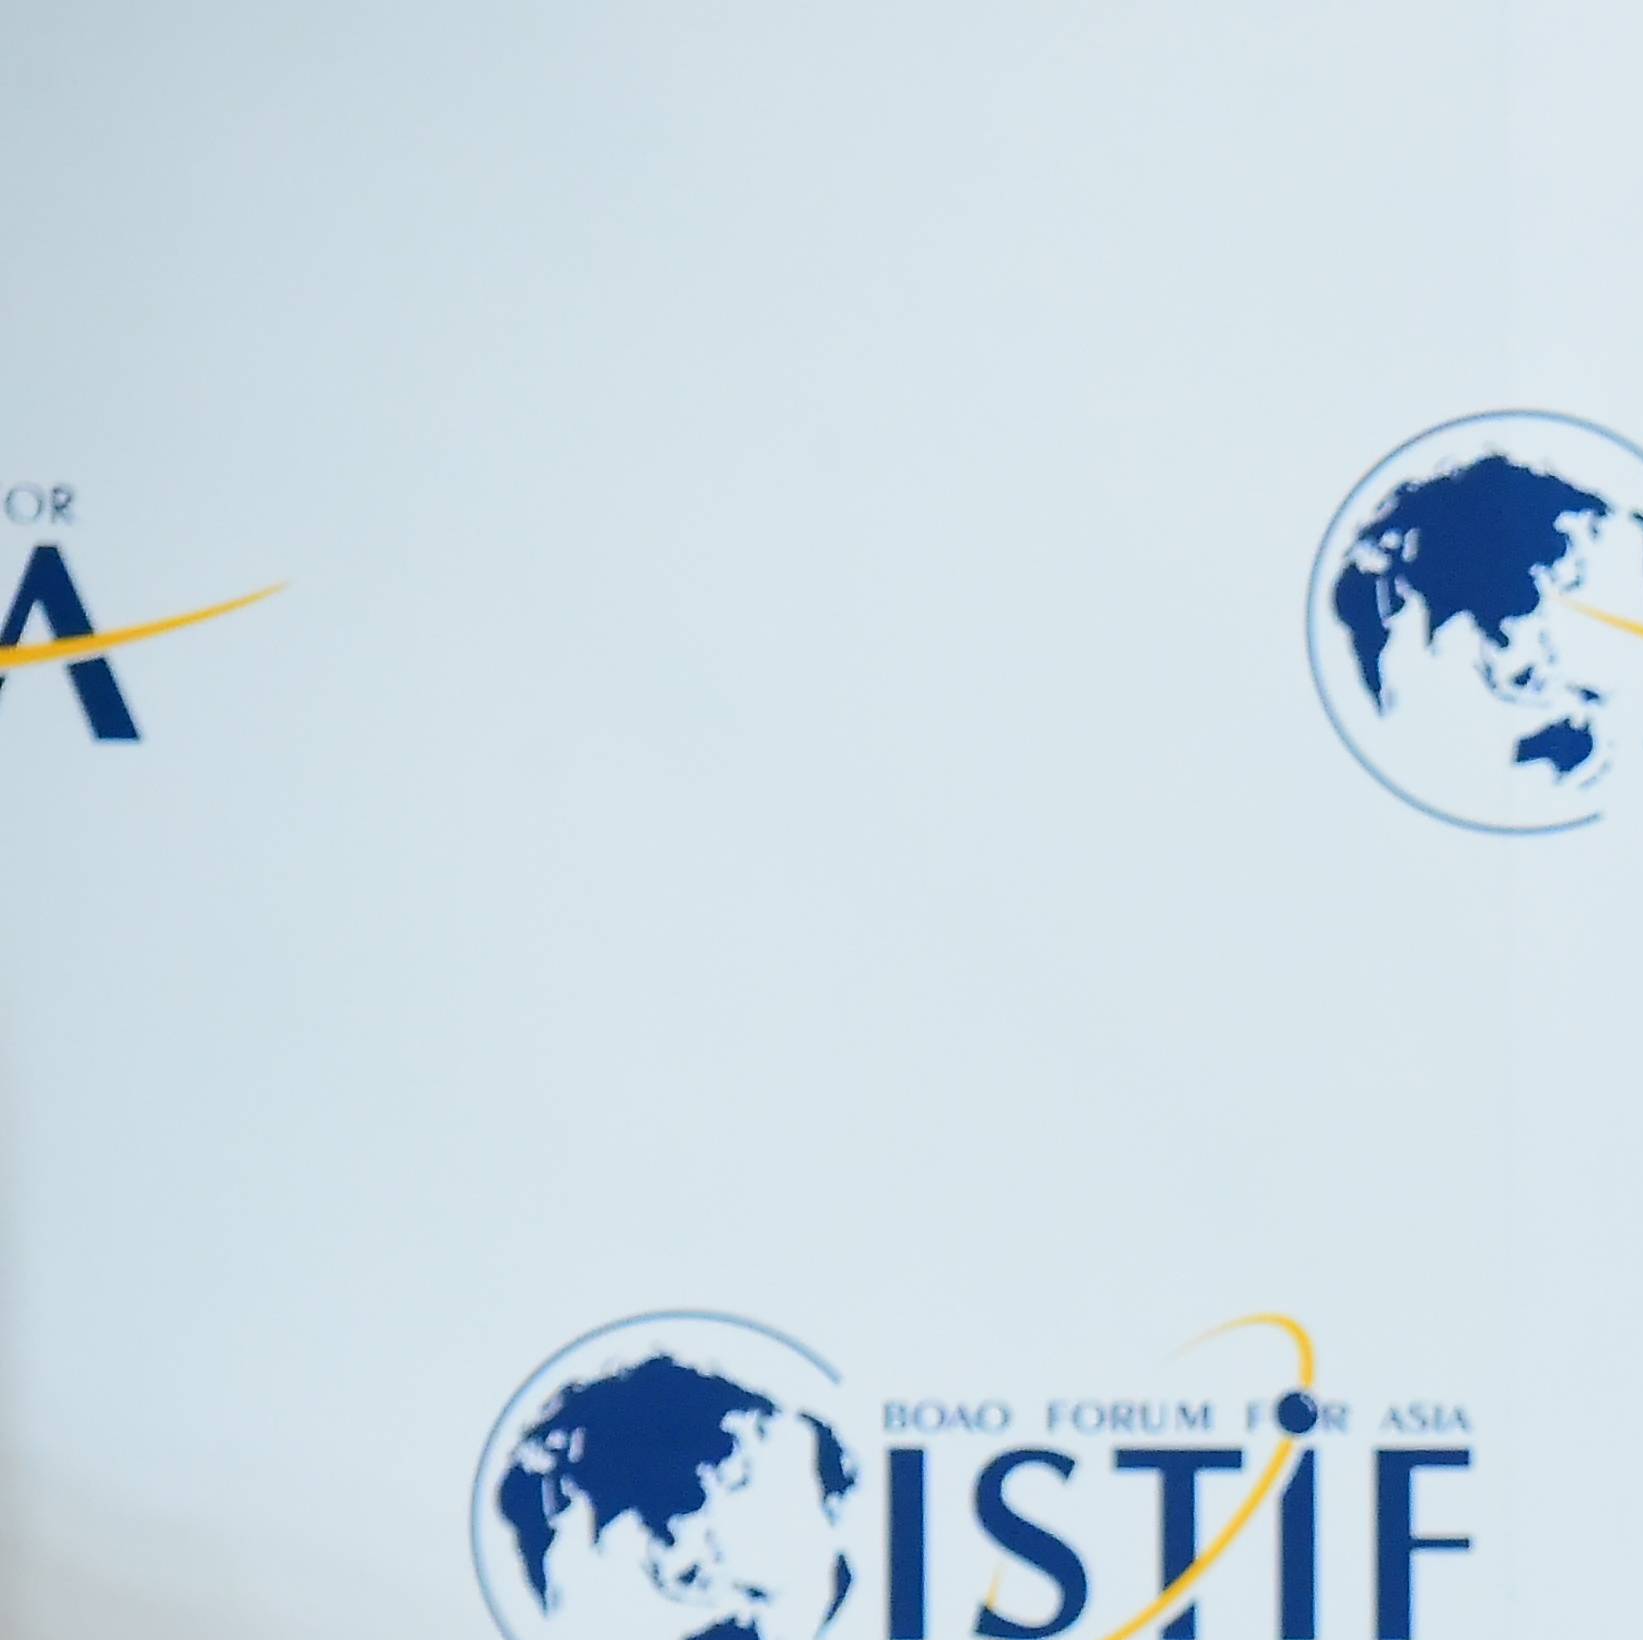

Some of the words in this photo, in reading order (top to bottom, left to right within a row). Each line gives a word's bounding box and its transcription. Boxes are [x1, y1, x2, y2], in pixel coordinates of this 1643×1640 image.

[4, 484, 75, 524] OR
[884, 1401, 1012, 1433] BOAO
[1047, 1401, 1214, 1433] FORUM
[1247, 1399, 1350, 1433] FR
[1380, 1402, 1473, 1432] ASIA
